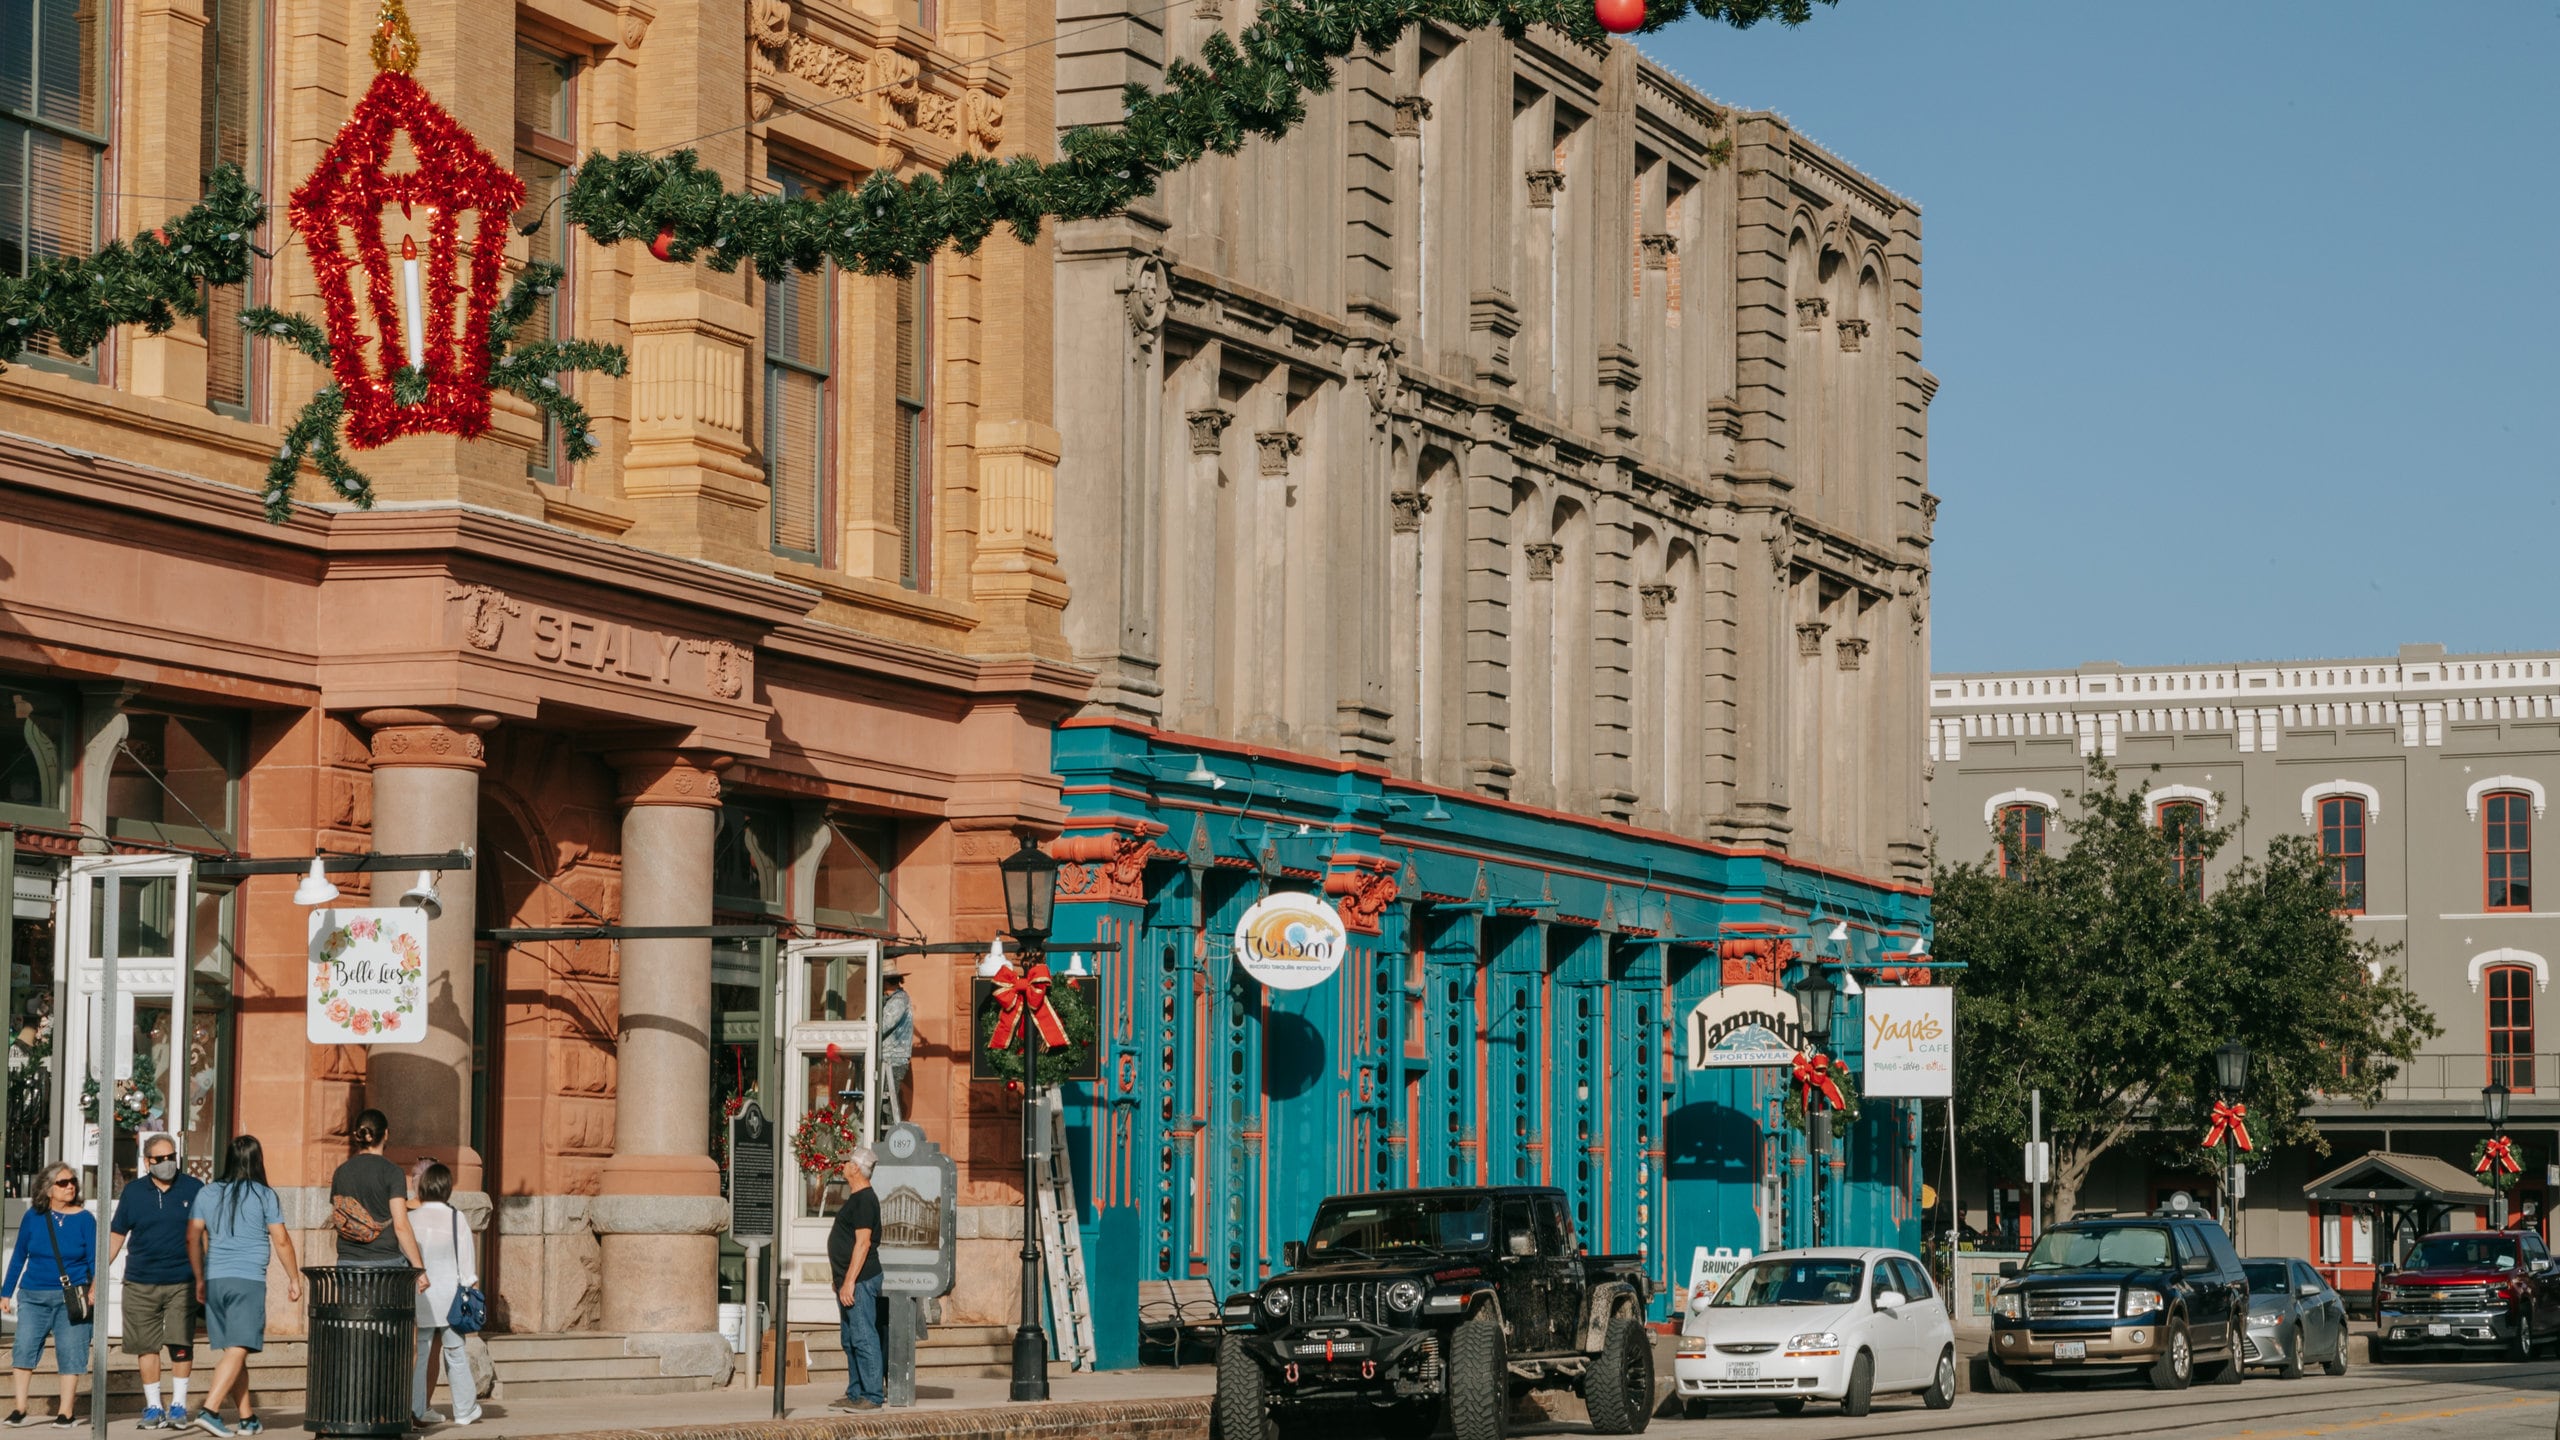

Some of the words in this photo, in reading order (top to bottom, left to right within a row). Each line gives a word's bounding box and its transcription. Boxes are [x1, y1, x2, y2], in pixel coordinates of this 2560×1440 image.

[531, 608, 680, 684] SEALY
[1241, 929, 1332, 962] tsunami
[335, 960, 375, 986] Belle
[377, 963, 404, 985] Lees
[1868, 1012, 1943, 1052] Yaga's
[1713, 1052, 1789, 1062] SPORTSWEAR
[1919, 1044, 1949, 1053] CAFE
[893, 1139, 911, 1149] 1897
[1702, 1261, 1739, 1274] BRUNCH
